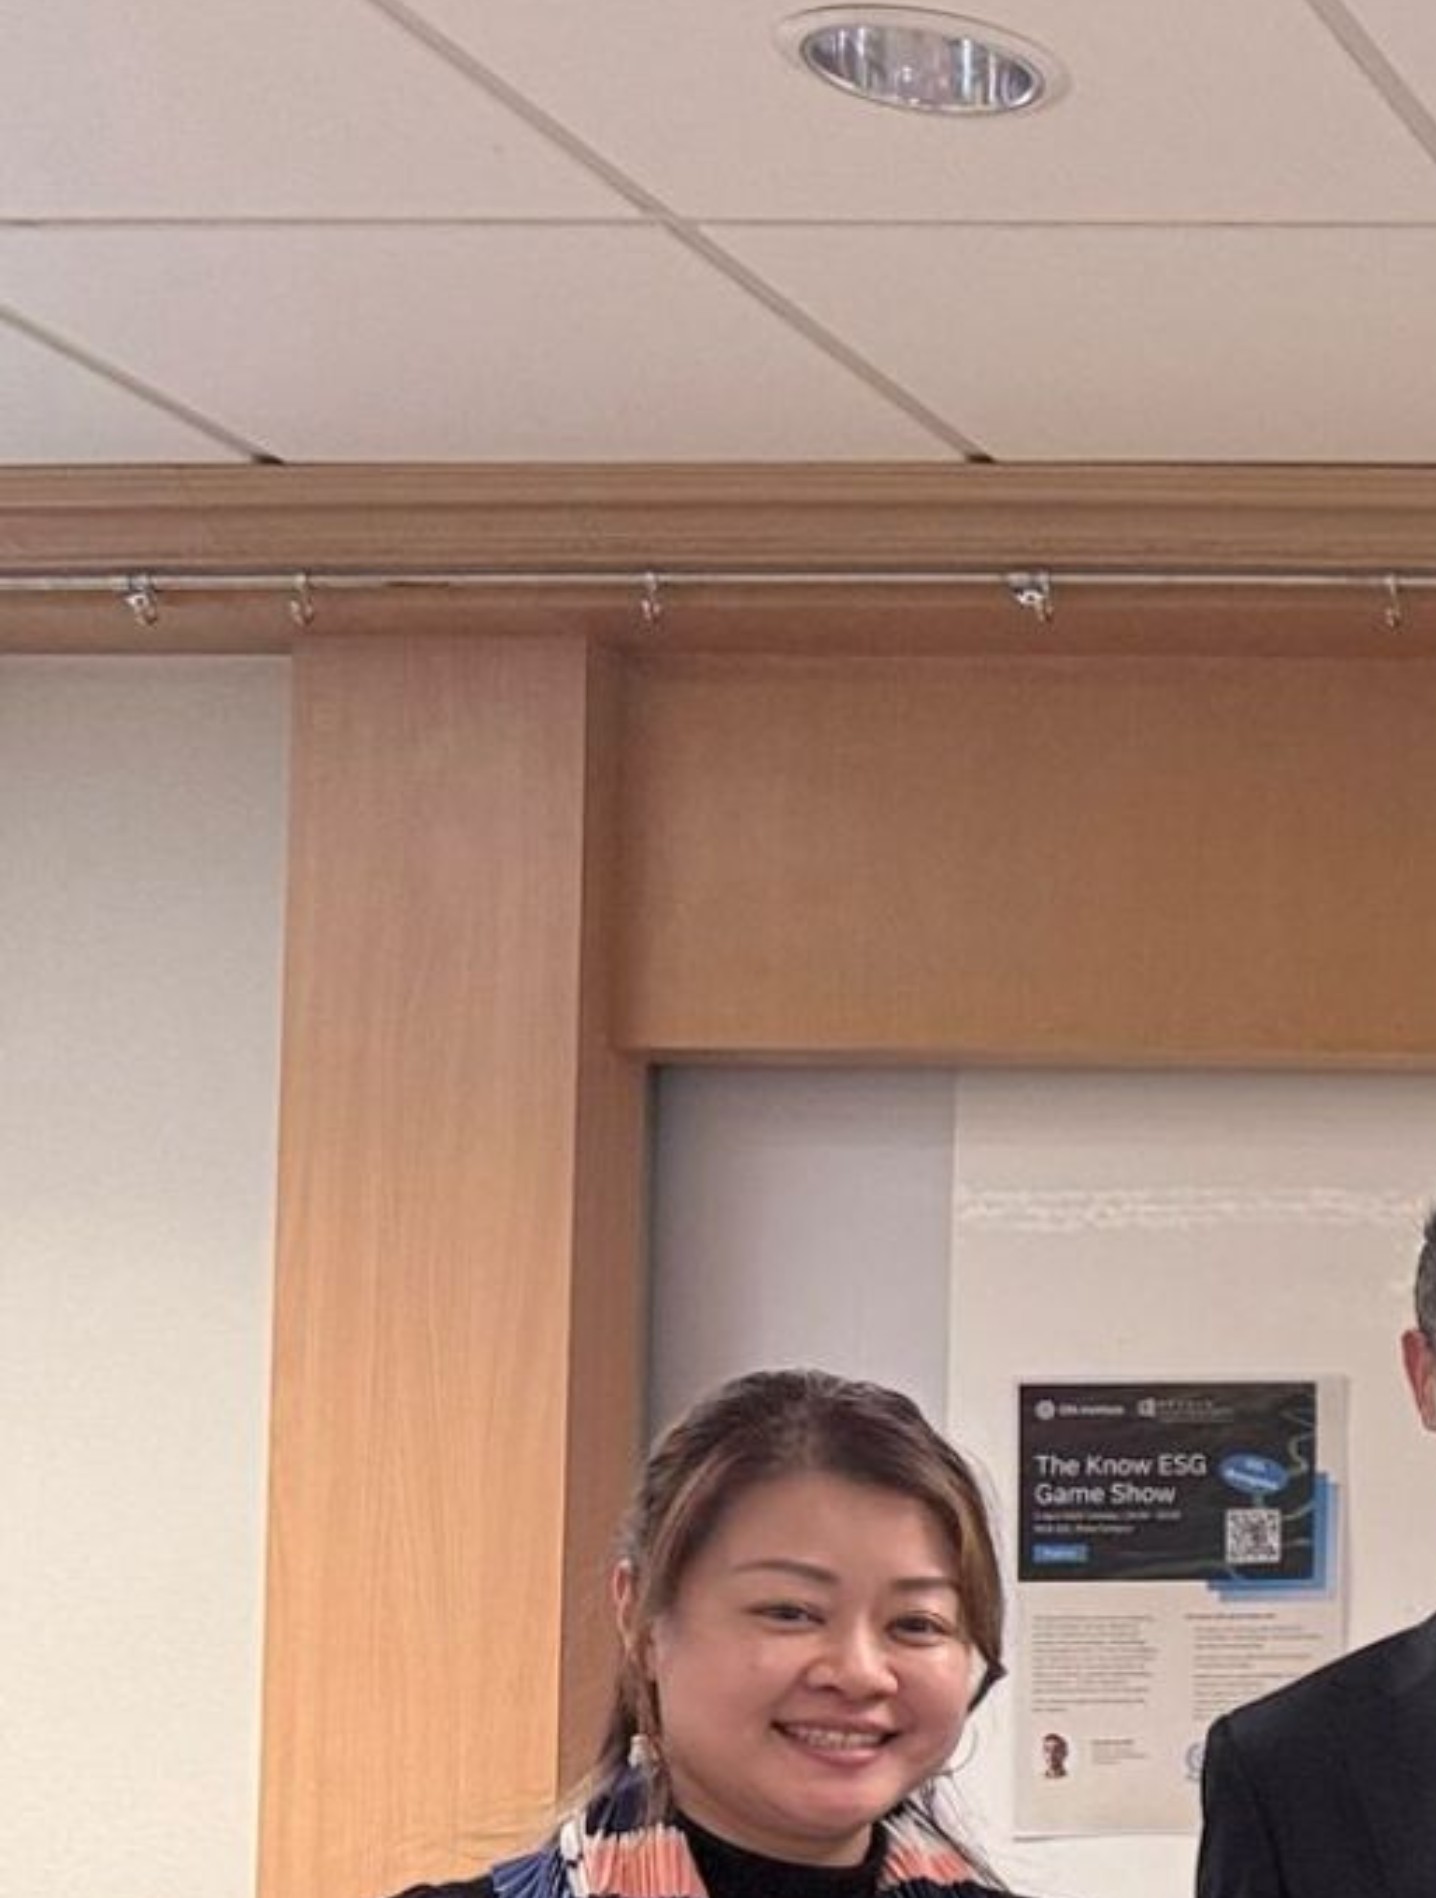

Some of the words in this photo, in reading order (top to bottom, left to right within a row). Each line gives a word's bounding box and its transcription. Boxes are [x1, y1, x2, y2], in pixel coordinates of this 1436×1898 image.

[1033, 1455, 1080, 1476] The
[1087, 1455, 1151, 1476] Know
[1158, 1453, 1207, 1476] ESG
[1034, 1484, 1105, 1505] Game
[1110, 1482, 1176, 1505] Show
